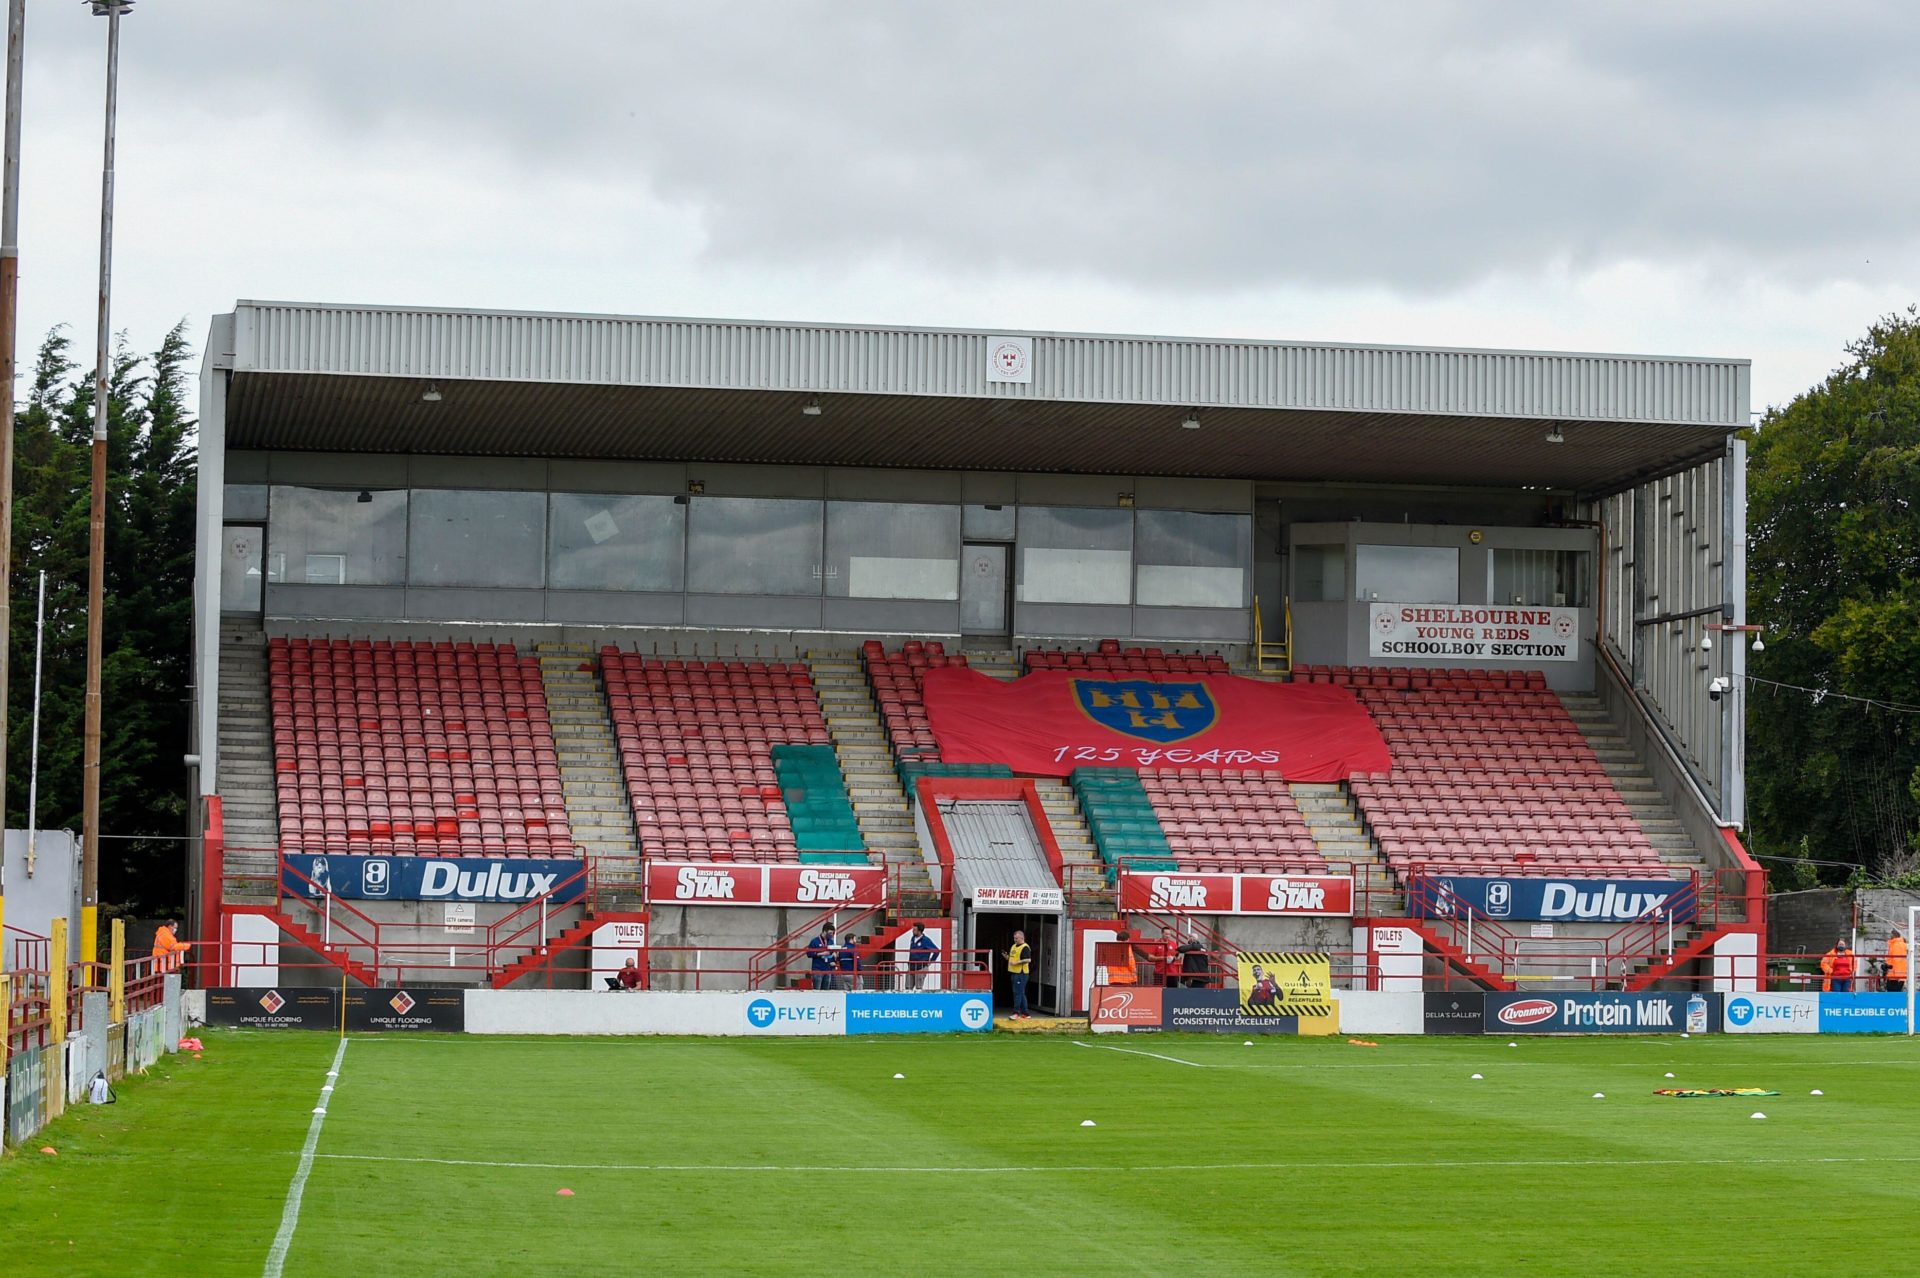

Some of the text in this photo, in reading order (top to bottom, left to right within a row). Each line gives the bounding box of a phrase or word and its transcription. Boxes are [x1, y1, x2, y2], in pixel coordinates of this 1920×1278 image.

[1401, 608, 1551, 625] SHELBOURNE
[1416, 626, 1530, 641] YOUNG REDS
[1382, 641, 1566, 657] SCHOOLBOY SECTION
[1053, 745, 1281, 764] 125 YEARS
[420, 861, 558, 899] Dulux
[676, 867, 735, 899] STAR
[797, 870, 856, 902] STAR
[977, 888, 1029, 899] SHAY WEAFER
[1150, 877, 1207, 908] STAR
[1268, 879, 1325, 910] STAR
[1540, 882, 1668, 918] Dulux
[614, 925, 644, 937] TOILETS
[1374, 930, 1403, 942] TOILETS
[852, 1009, 943, 1019] THE FLEXIBLE GYM
[1099, 1008, 1129, 1019] DCU
[1173, 1008, 1235, 1016] PURPOSEFULLY
[1563, 999, 1673, 1026] Protein Milk
[1824, 1008, 1908, 1016] THE FLEXIBLE GYM
[1173, 1017, 1281, 1026] CONSISTENTLY EXCELLENT
